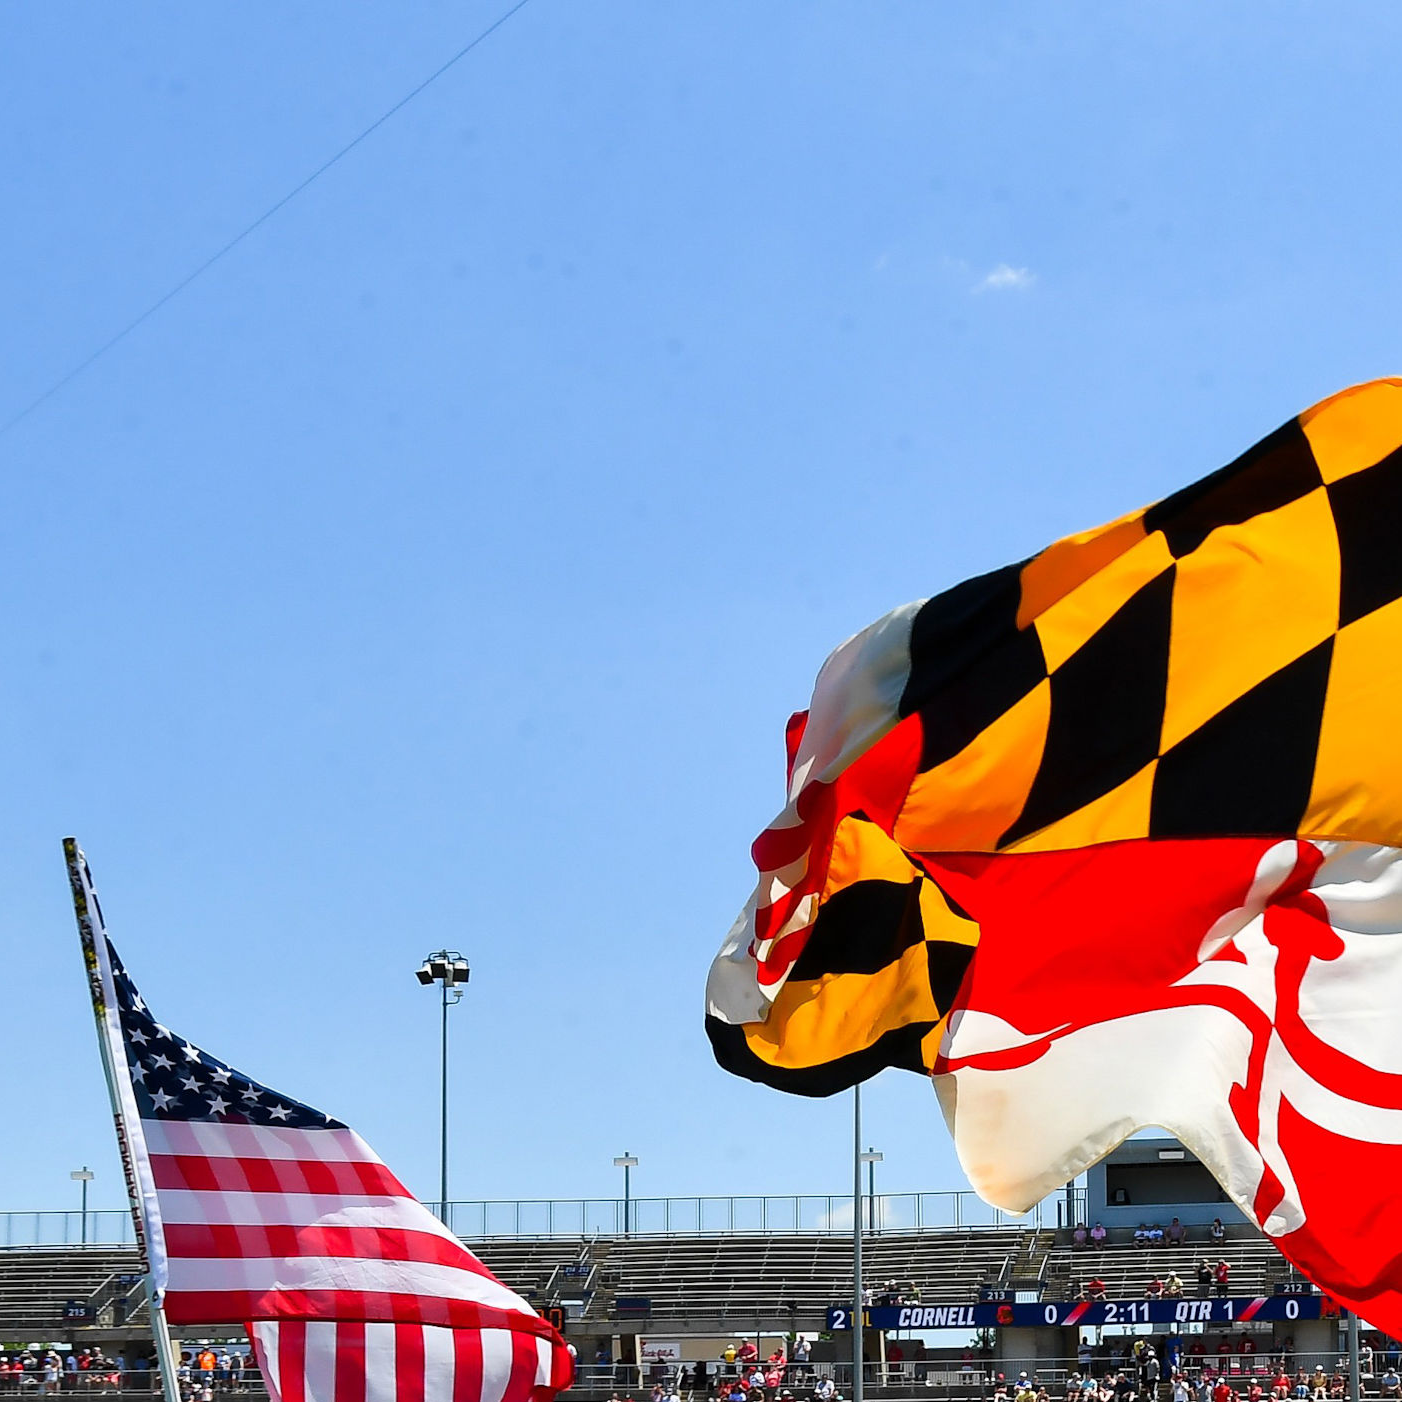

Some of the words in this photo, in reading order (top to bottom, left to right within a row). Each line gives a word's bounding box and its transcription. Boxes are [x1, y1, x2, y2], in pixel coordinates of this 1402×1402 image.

[114, 1113, 139, 1200] ARMOUR
[130, 1206, 150, 1274] UNDER
[987, 1291, 1005, 1300] 213
[1283, 1283, 1303, 1293] 212
[68, 1308, 86, 1317] 215
[832, 1309, 846, 1329] 2
[898, 1306, 976, 1327] CORNELL
[1044, 1304, 1057, 1324] 0
[1104, 1302, 1149, 1322] 2:11
[1175, 1300, 1212, 1321] QTR
[1223, 1300, 1234, 1320] 1
[1285, 1299, 1299, 1320] 0
